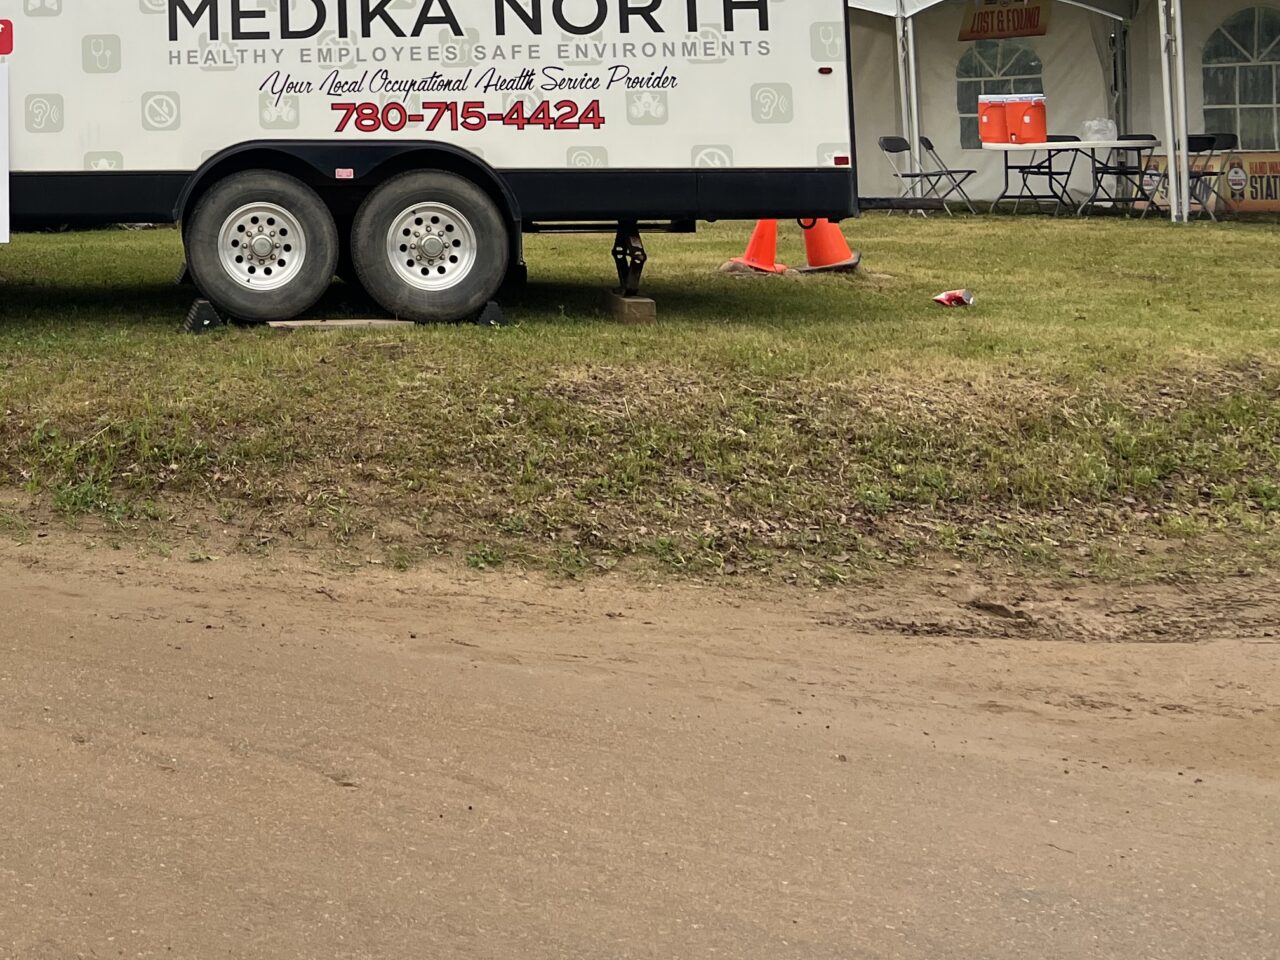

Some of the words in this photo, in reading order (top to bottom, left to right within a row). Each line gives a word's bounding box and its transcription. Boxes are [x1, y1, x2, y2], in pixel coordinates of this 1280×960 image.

[970, 10, 995, 34] LOST
[996, 10, 1005, 32] &
[1006, 6, 1040, 32] FOUND
[168, 47, 284, 65] HEALTHY
[300, 45, 458, 63] EMPLOYEES
[474, 44, 541, 60] SAFE
[557, 40, 771, 59] ENVIRONMENTS
[259, 69, 313, 107] Your
[318, 66, 368, 97] Local
[370, 66, 472, 103] Occupational
[474, 66, 535, 94] Health
[540, 65, 600, 91] Service
[606, 64, 678, 90] Provider
[331, 99, 605, 133] 780-715-4424
[1250, 175, 1280, 200] STAT
